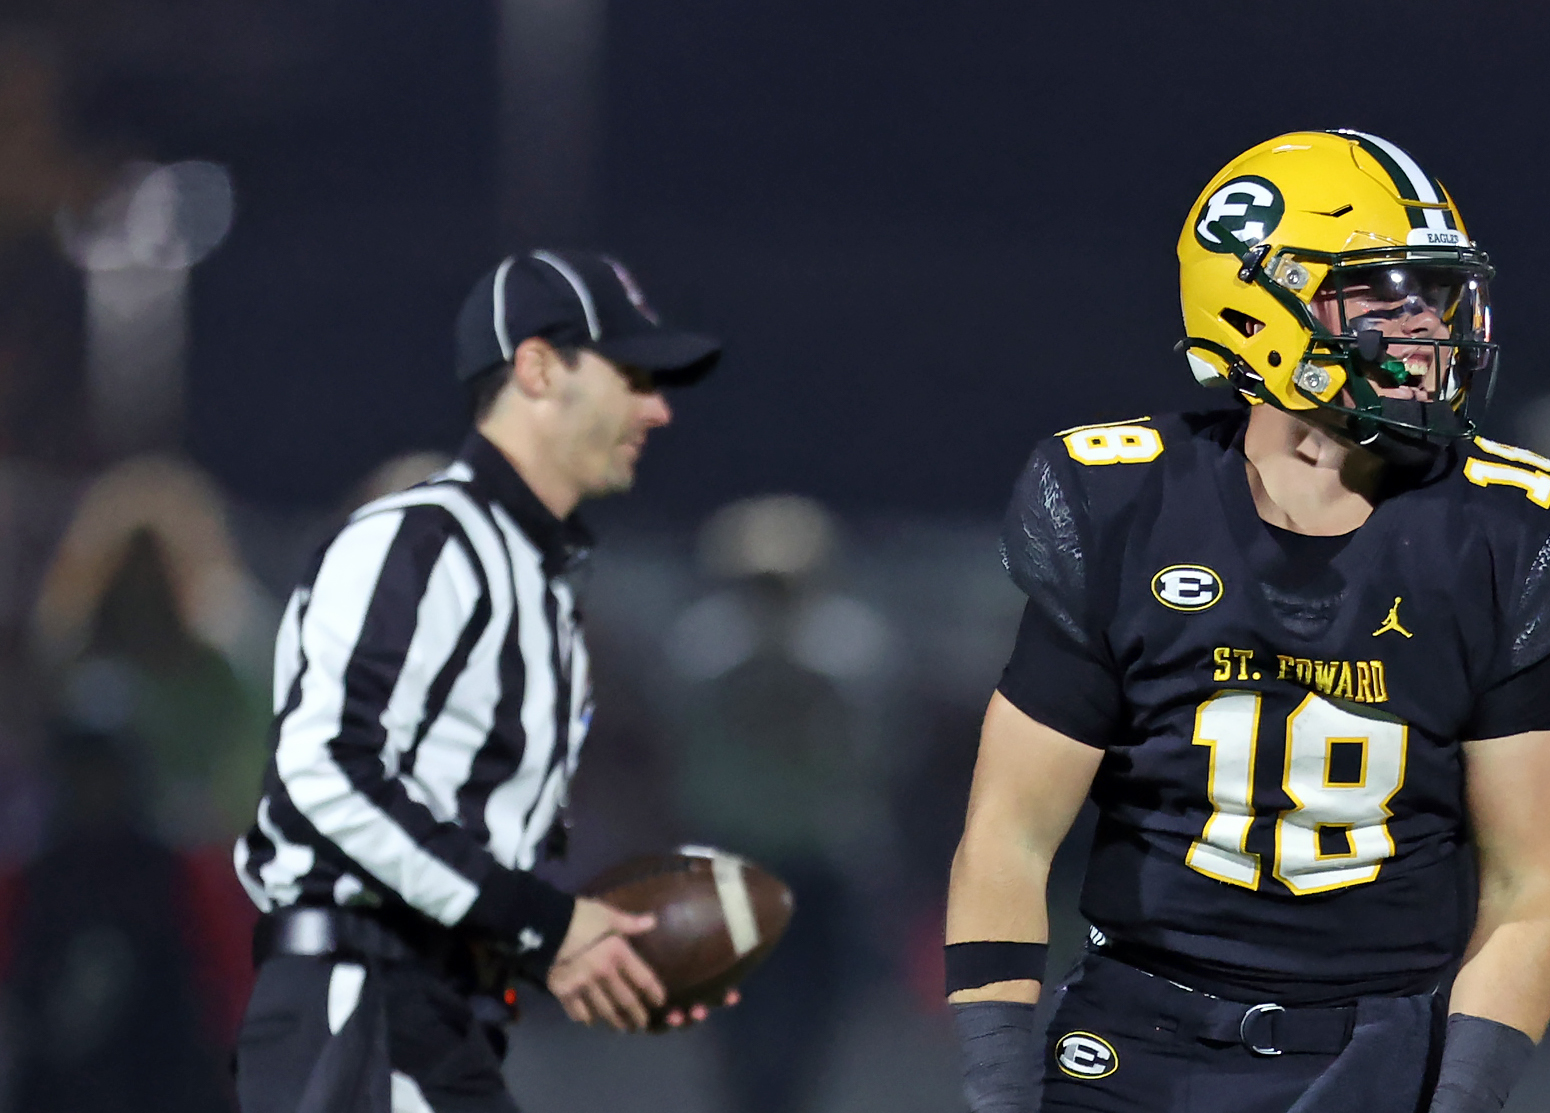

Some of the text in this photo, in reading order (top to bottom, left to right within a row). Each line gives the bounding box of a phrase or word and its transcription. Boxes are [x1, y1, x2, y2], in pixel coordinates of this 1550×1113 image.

[1426, 233, 1459, 244] EAGLES
[1213, 647, 1262, 682] ST.
[1185, 689, 1409, 896] 18
